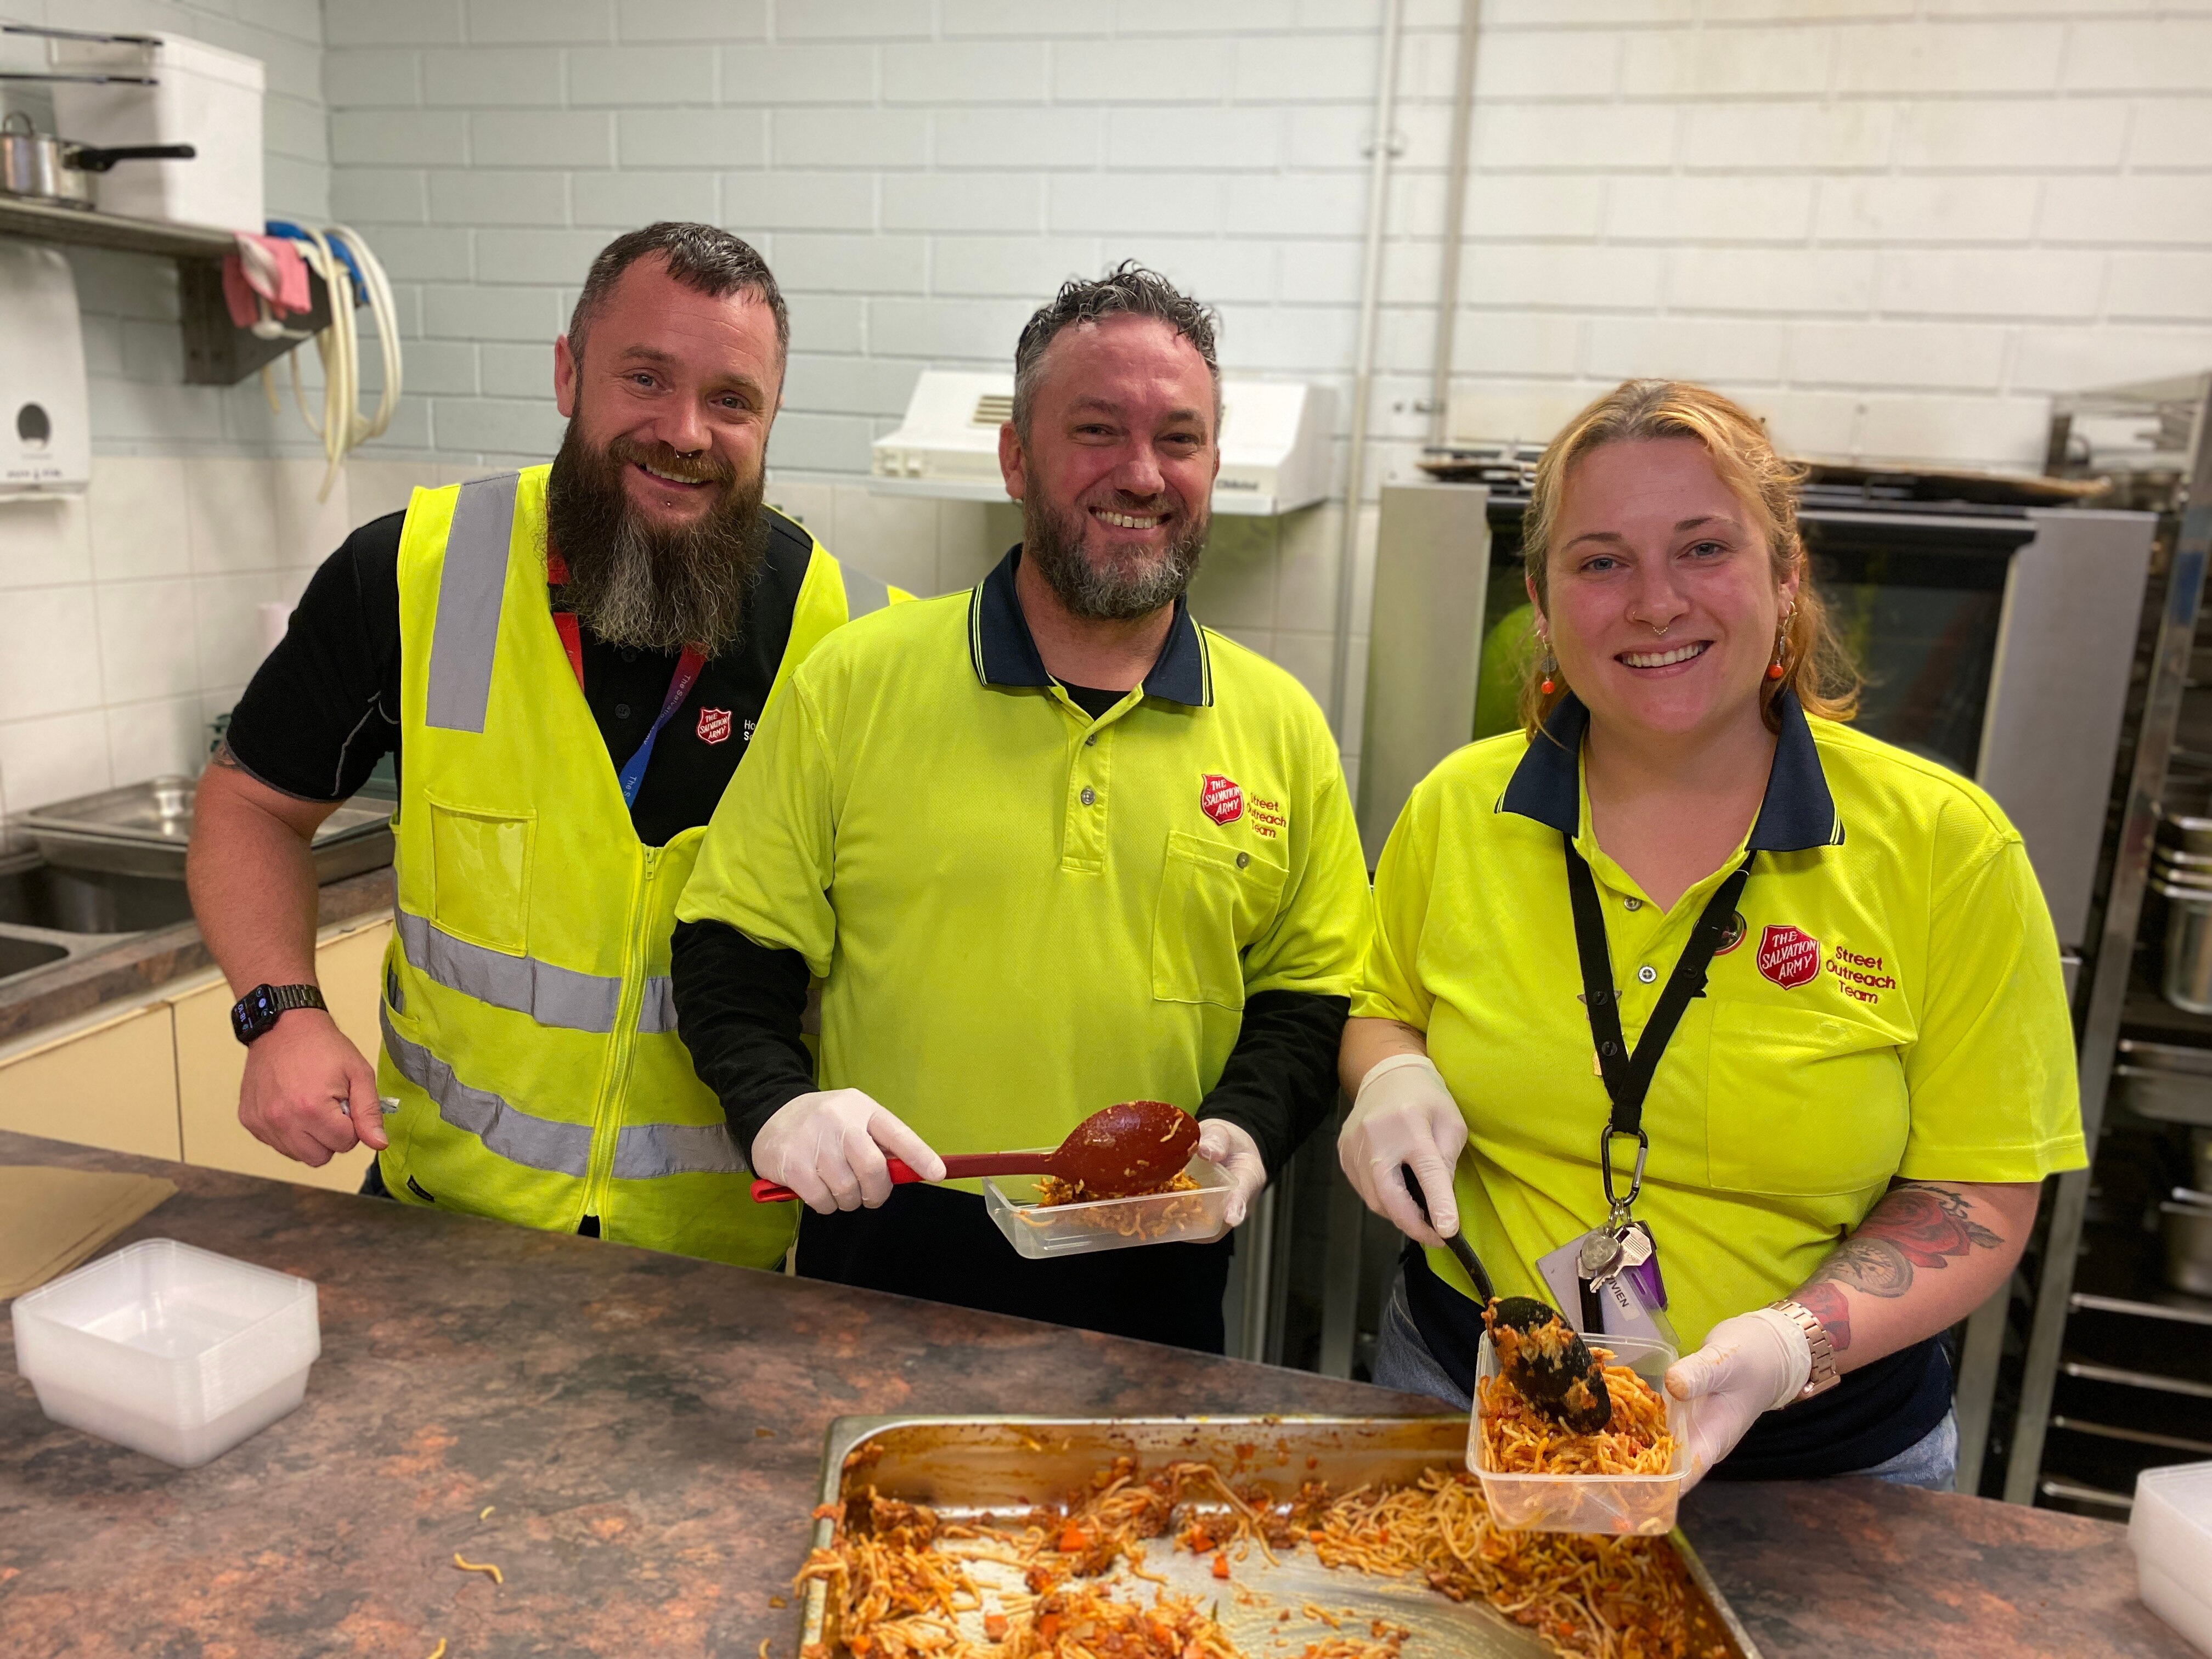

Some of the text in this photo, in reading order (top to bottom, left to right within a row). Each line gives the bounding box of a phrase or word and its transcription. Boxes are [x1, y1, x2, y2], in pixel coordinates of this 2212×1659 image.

[680, 675, 691, 689] The
[699, 716, 728, 734] SALVATION
[704, 713, 718, 723] THE
[744, 719, 756, 730] Ho
[708, 725, 726, 740] ARMY
[625, 776, 637, 789] The
[1210, 779, 1227, 791] THE
[1204, 786, 1240, 806] SALVATION
[1250, 792, 1279, 812] Street
[1215, 798, 1239, 816] ARMY
[1246, 803, 1286, 828] Outreach
[1251, 819, 1276, 838] Team
[1772, 930, 1798, 947] THE
[1762, 940, 1816, 970] SALVATION
[1835, 945, 1882, 971] Street
[1778, 953, 1813, 980] ARMY
[1826, 959, 1895, 989] Outreach
[1838, 980, 1878, 1004] Team
